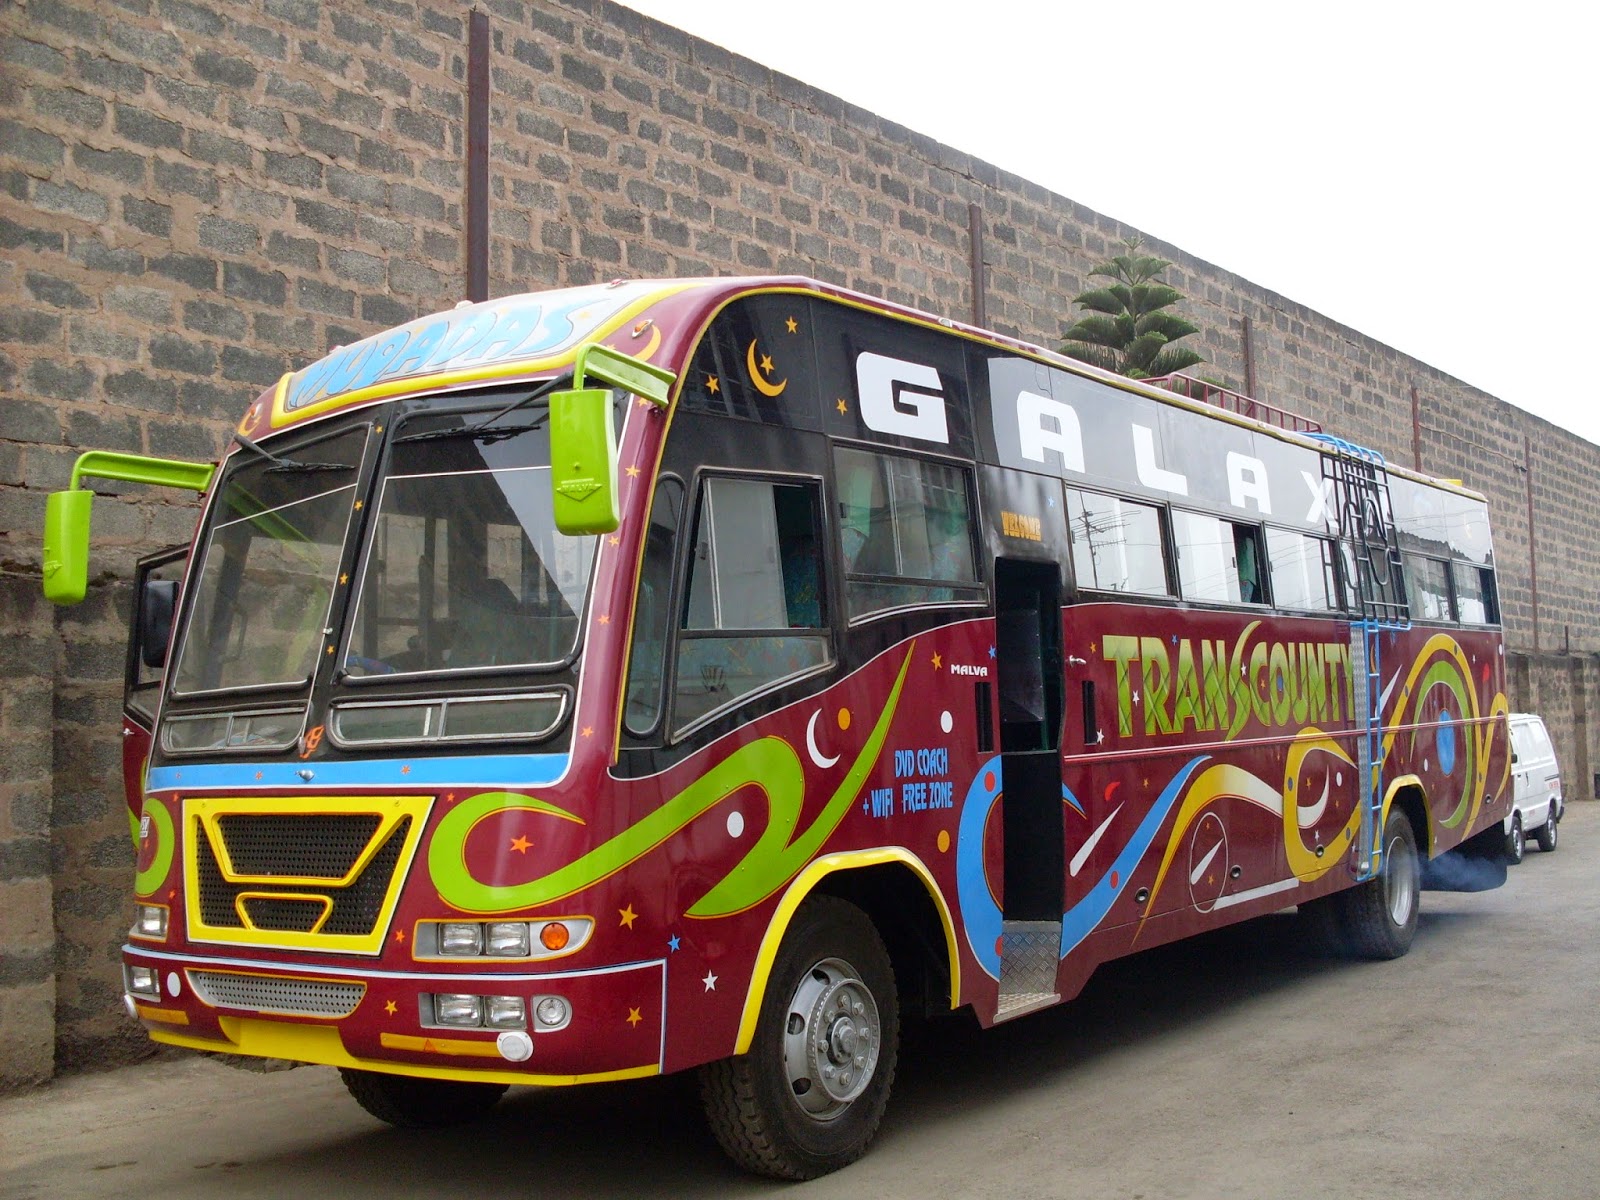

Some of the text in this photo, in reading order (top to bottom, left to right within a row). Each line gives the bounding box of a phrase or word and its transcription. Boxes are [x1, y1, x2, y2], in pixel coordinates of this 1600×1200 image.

[1001, 510, 1042, 542] WELCOME
[950, 664, 988, 677] MALVA
[894, 748, 948, 778] DVD COACH
[871, 788, 894, 819] WIFI
[902, 782, 927, 814] FREE
[929, 781, 953, 809] ZONE
